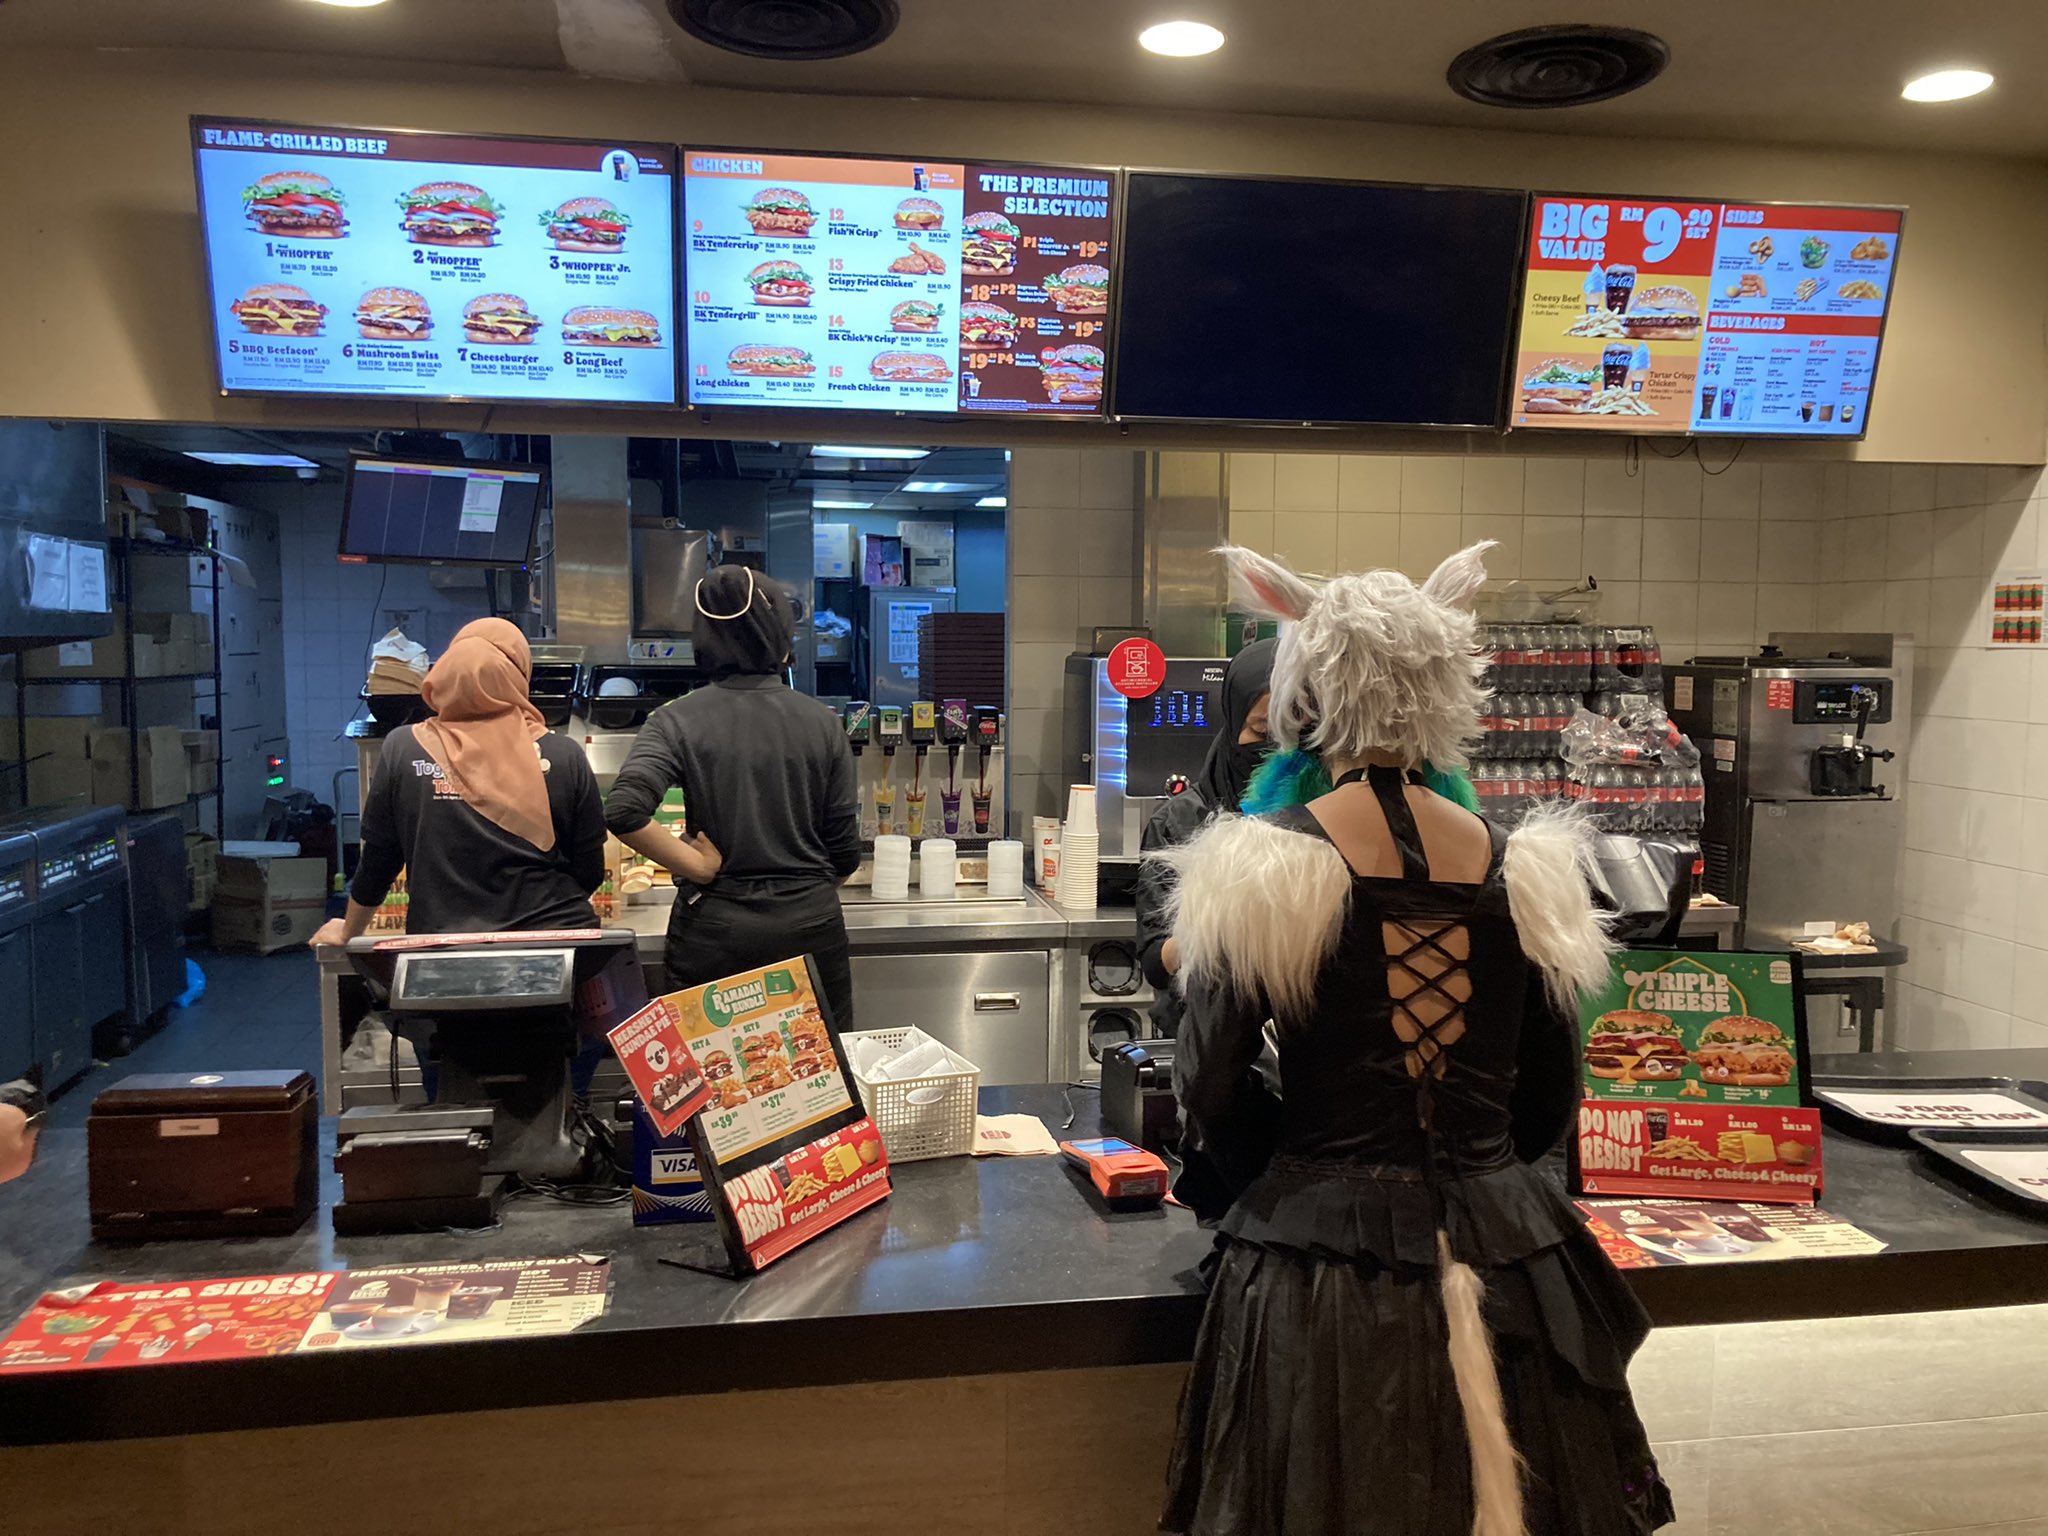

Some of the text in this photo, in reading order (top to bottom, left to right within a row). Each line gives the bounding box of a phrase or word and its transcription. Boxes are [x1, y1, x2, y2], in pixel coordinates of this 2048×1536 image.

[204, 129, 387, 155] FLAME-GRILLED BEEF
[691, 157, 763, 175] CHICKEN
[979, 174, 1109, 197] THE PREMIUM
[829, 208, 844, 221] 12
[1004, 196, 1108, 219] SELECTION
[1725, 210, 1764, 225] SIDES
[693, 220, 703, 232] 9
[1540, 202, 1610, 240] BIG
[1620, 207, 1644, 222] RM
[1642, 206, 1683, 263] 9
[265, 242, 274, 257] 1
[1022, 236, 1098, 258] P1 19
[1538, 239, 1605, 261] VALUE
[413, 249, 424, 264] 2
[549, 255, 560, 269] 3
[617, 264, 631, 273] Jr.
[829, 258, 843, 271] 13
[828, 277, 856, 287] Crispy
[857, 278, 879, 286] Fried
[694, 291, 711, 304] 10
[971, 283, 1016, 301] 18 P2
[1533, 293, 1581, 304] Cheesy Beef
[828, 315, 844, 327] 14
[1020, 316, 1094, 337] P3 19
[1710, 316, 1786, 331] BEVERAGES
[828, 333, 841, 341] BK
[229, 340, 239, 353] 5
[242, 345, 264, 355] BBQ
[342, 344, 353, 358] 6
[357, 349, 410, 358] Mushroom
[411, 350, 439, 360] Swiss
[457, 348, 539, 365] 7 Cheeseburger
[563, 351, 574, 365] 8
[576, 357, 600, 367] Long
[601, 357, 623, 367] Beef
[969, 353, 1015, 369] 19 P4
[828, 366, 843, 378] 15
[1649, 371, 1697, 381] Tartar Crispy
[695, 378, 750, 388] Long chicken
[828, 383, 857, 391] French
[858, 384, 891, 392] Chicken
[412, 760, 444, 779] Tog
[1624, 970, 1729, 993] TRIPLE
[730, 994, 766, 1014] BUNDLE
[1638, 990, 1731, 1013] CHEESE
[784, 1007, 801, 1019] SET C
[613, 1002, 667, 1046] HERSHEY'S
[743, 1023, 756, 1033] SET
[620, 1015, 673, 1058] SUNDAE PIE
[692, 1038, 711, 1051] SET A
[1865, 1111, 2041, 1121] COLLECTION
[1896, 1105, 1973, 1113] FOOD
[1580, 1106, 1602, 1136] DO
[1606, 1109, 1644, 1144] NOT
[1581, 1135, 1644, 1172] RESIST
[659, 1158, 698, 1173] VISA
[1649, 1165, 1672, 1177] Get
[1672, 1165, 1713, 1181] Large,
[723, 1164, 778, 1211] DO NOT
[737, 1196, 786, 1246] RESIST
[349, 1267, 417, 1278] FRESHLY
[484, 1260, 536, 1271] FINELY
[199, 1273, 336, 1297] SIDES!
